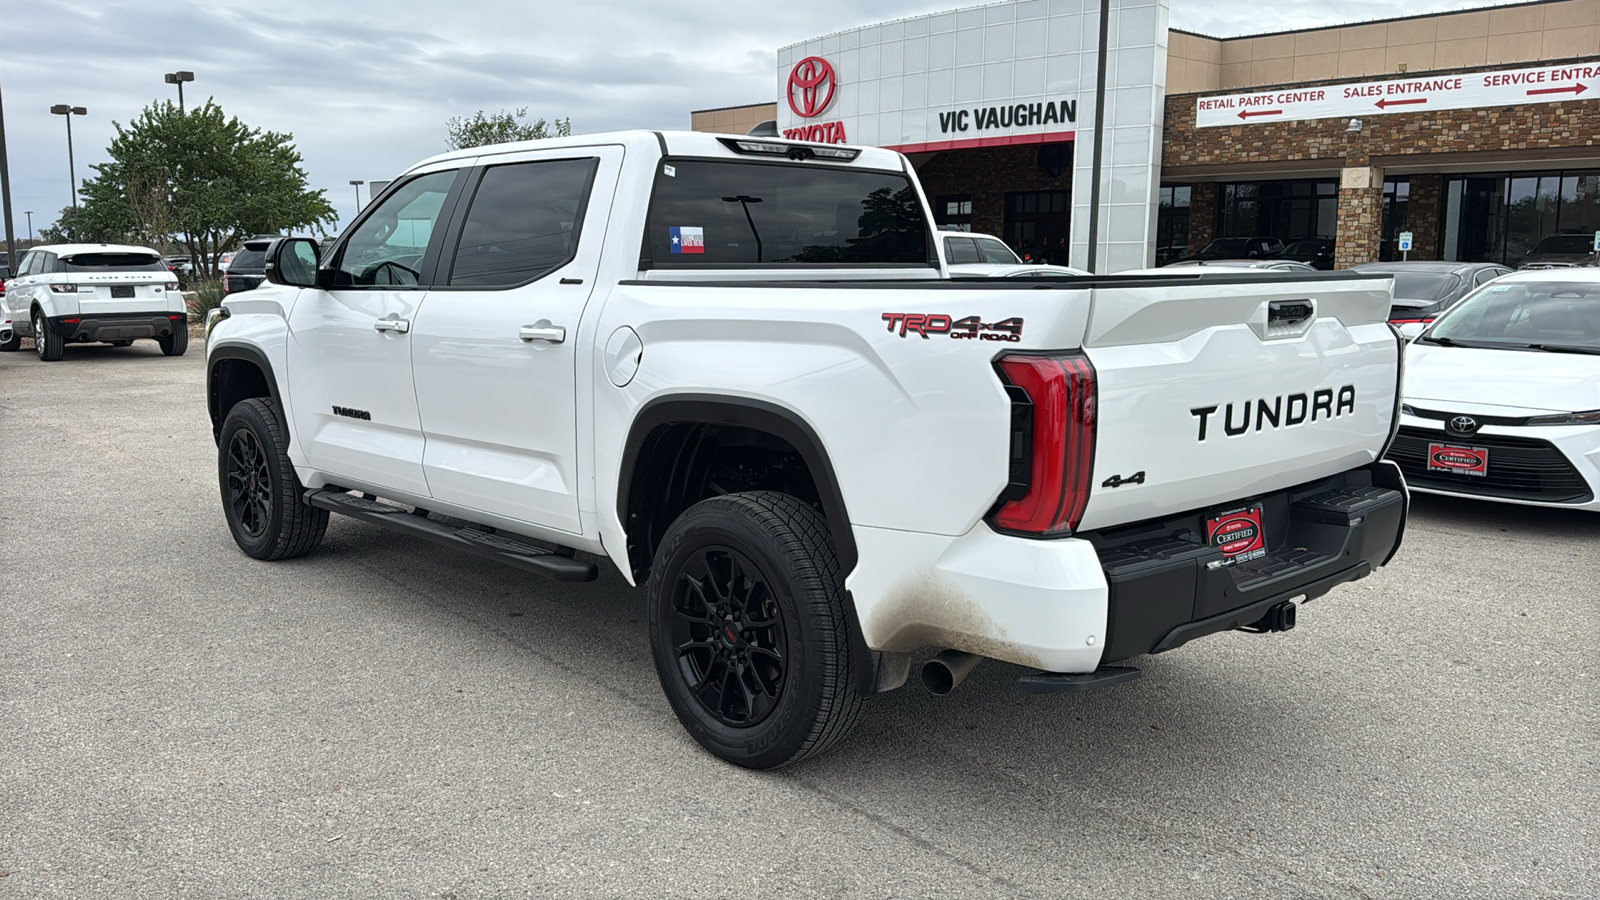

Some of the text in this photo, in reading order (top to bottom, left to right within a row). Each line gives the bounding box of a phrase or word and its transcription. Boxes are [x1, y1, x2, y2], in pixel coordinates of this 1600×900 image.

[1343, 78, 1463, 99] SALES ENTRANCE
[1483, 71, 1546, 87] SERVICE
[1199, 90, 1325, 110] RETAIL PARTS CENTER
[939, 99, 1077, 133] VIC VAUGHAN
[783, 121, 847, 144] TOYOTA
[882, 313, 952, 340] TRD
[950, 332, 1021, 342] OFF ROAD
[331, 405, 371, 421] TUNDRA
[1190, 383, 1356, 442] TUNDRA
[1439, 455, 1477, 464] CERTIFIED
[1217, 528, 1252, 544] CERTIFIED
[725, 625, 737, 644] TRD
